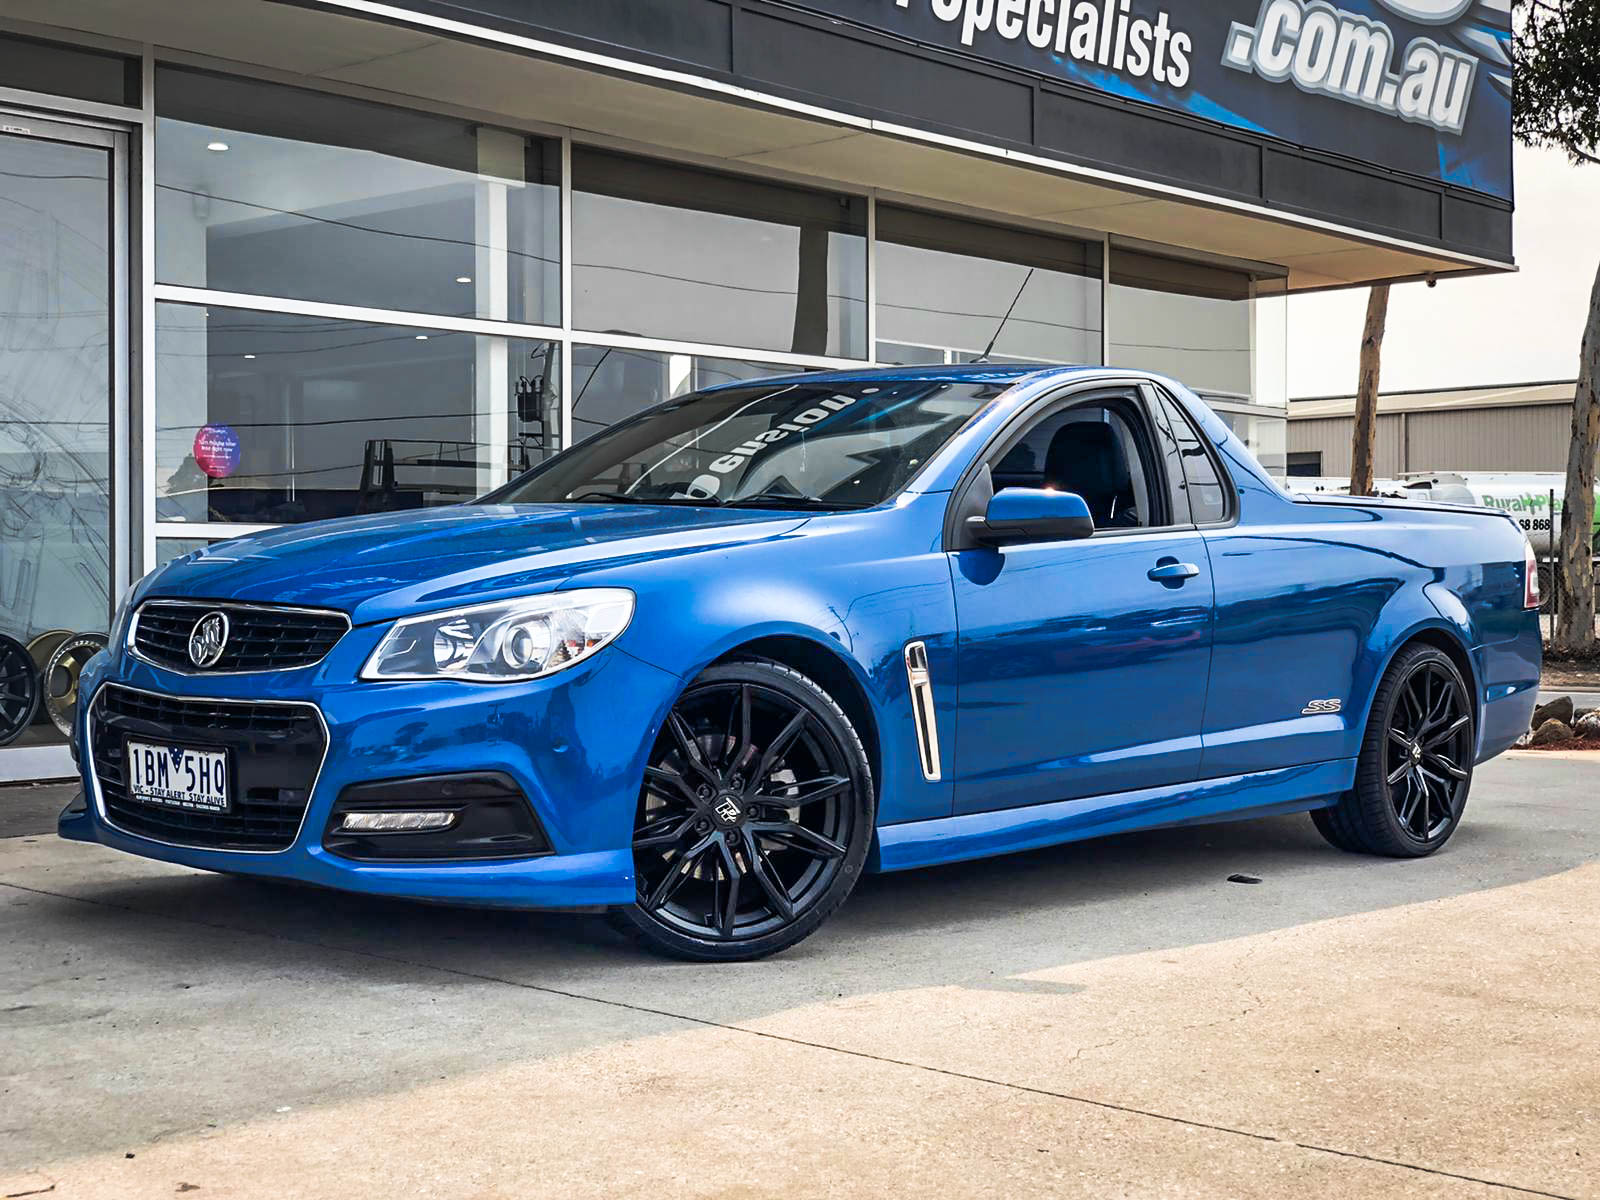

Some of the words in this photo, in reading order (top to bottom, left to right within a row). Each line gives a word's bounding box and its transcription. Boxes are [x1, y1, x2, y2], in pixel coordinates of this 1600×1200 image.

[1228, 0, 1472, 128] .com.au
[1482, 494, 1526, 512] Rural
[1532, 519, 1550, 531] 868
[1301, 698, 1342, 715] SS
[133, 748, 169, 789] 1BM
[184, 755, 225, 796] 5HQ
[133, 784, 144, 794] VIC
[150, 787, 165, 797] STAY
[166, 789, 186, 801] ALERT
[188, 792, 204, 804] STAY
[205, 795, 226, 806] ALIVE
